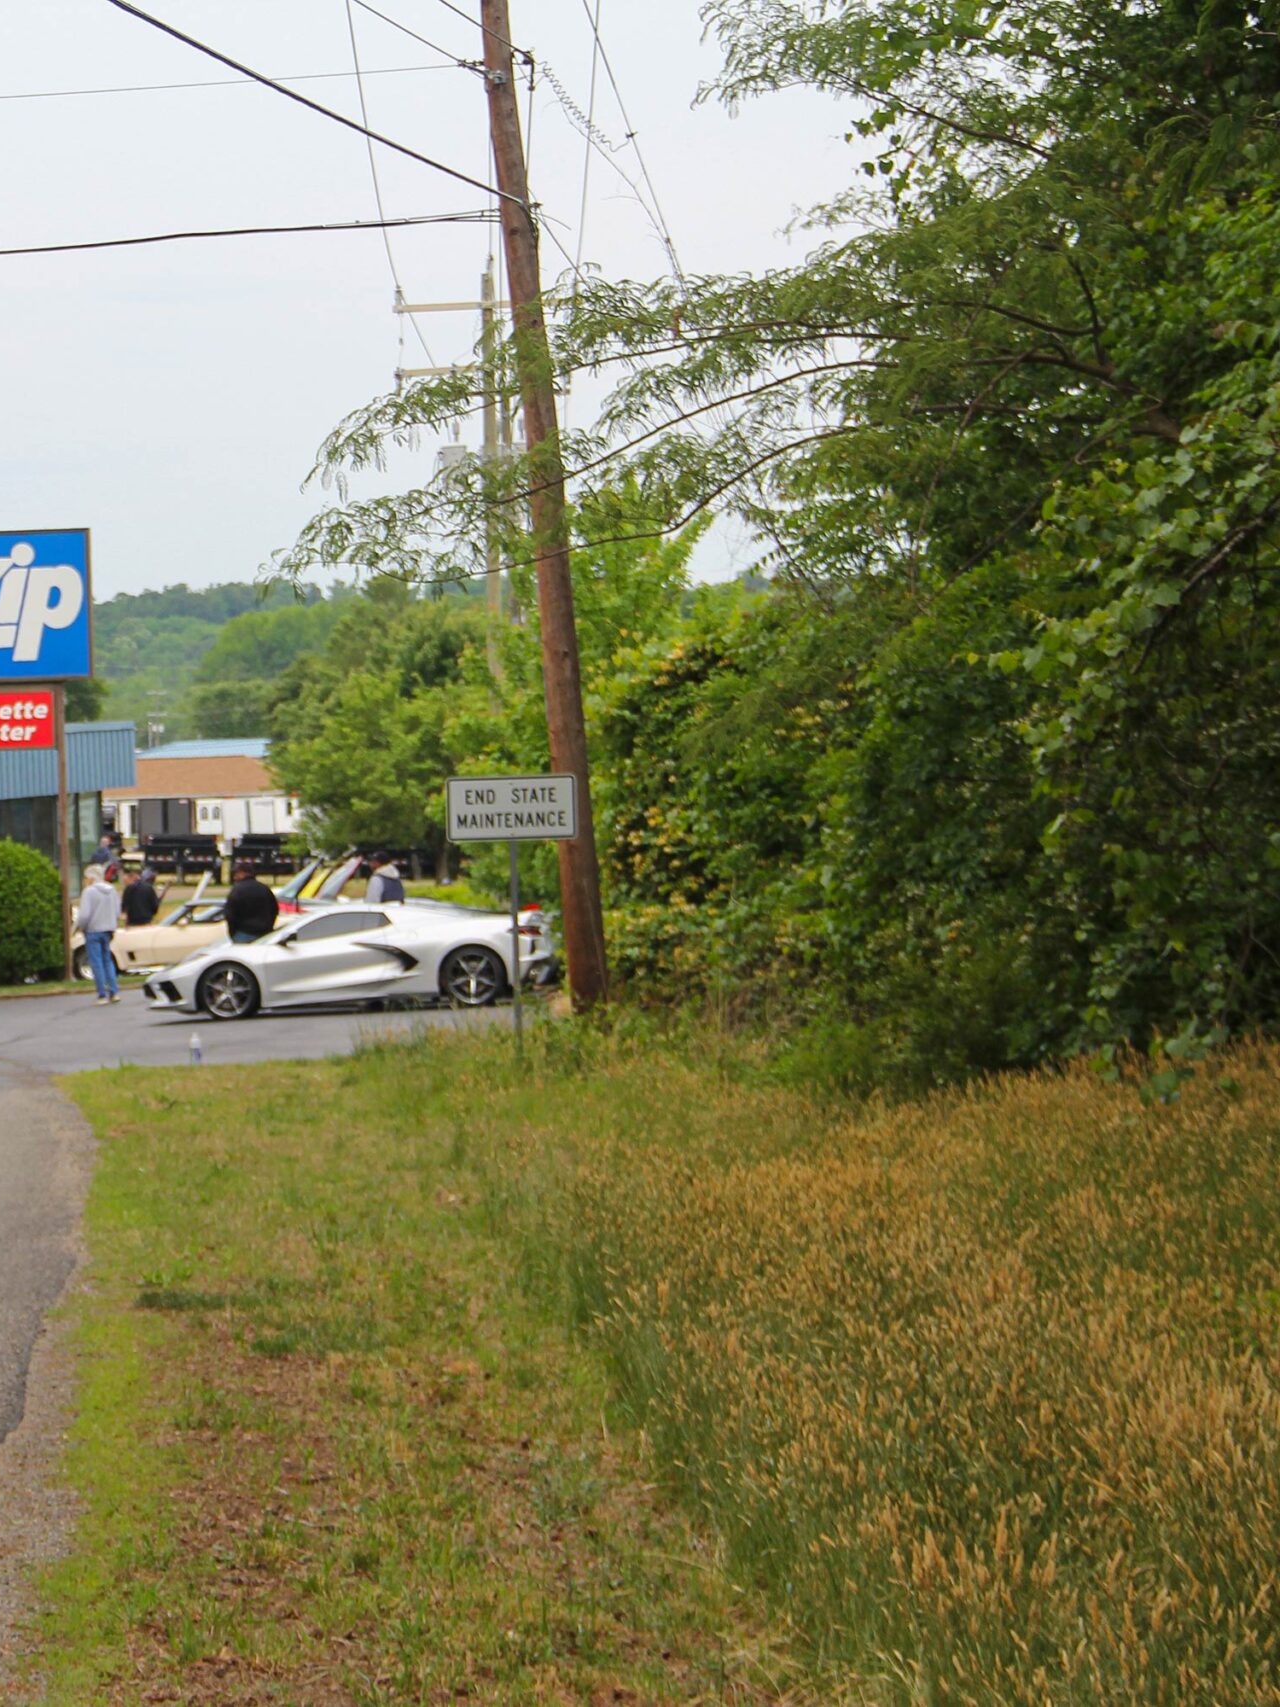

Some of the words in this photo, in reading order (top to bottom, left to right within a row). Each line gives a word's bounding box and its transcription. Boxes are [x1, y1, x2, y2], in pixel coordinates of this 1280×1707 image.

[465, 789, 496, 805] END
[511, 787, 557, 803] STATE
[456, 811, 567, 829] MAINTENANCE
